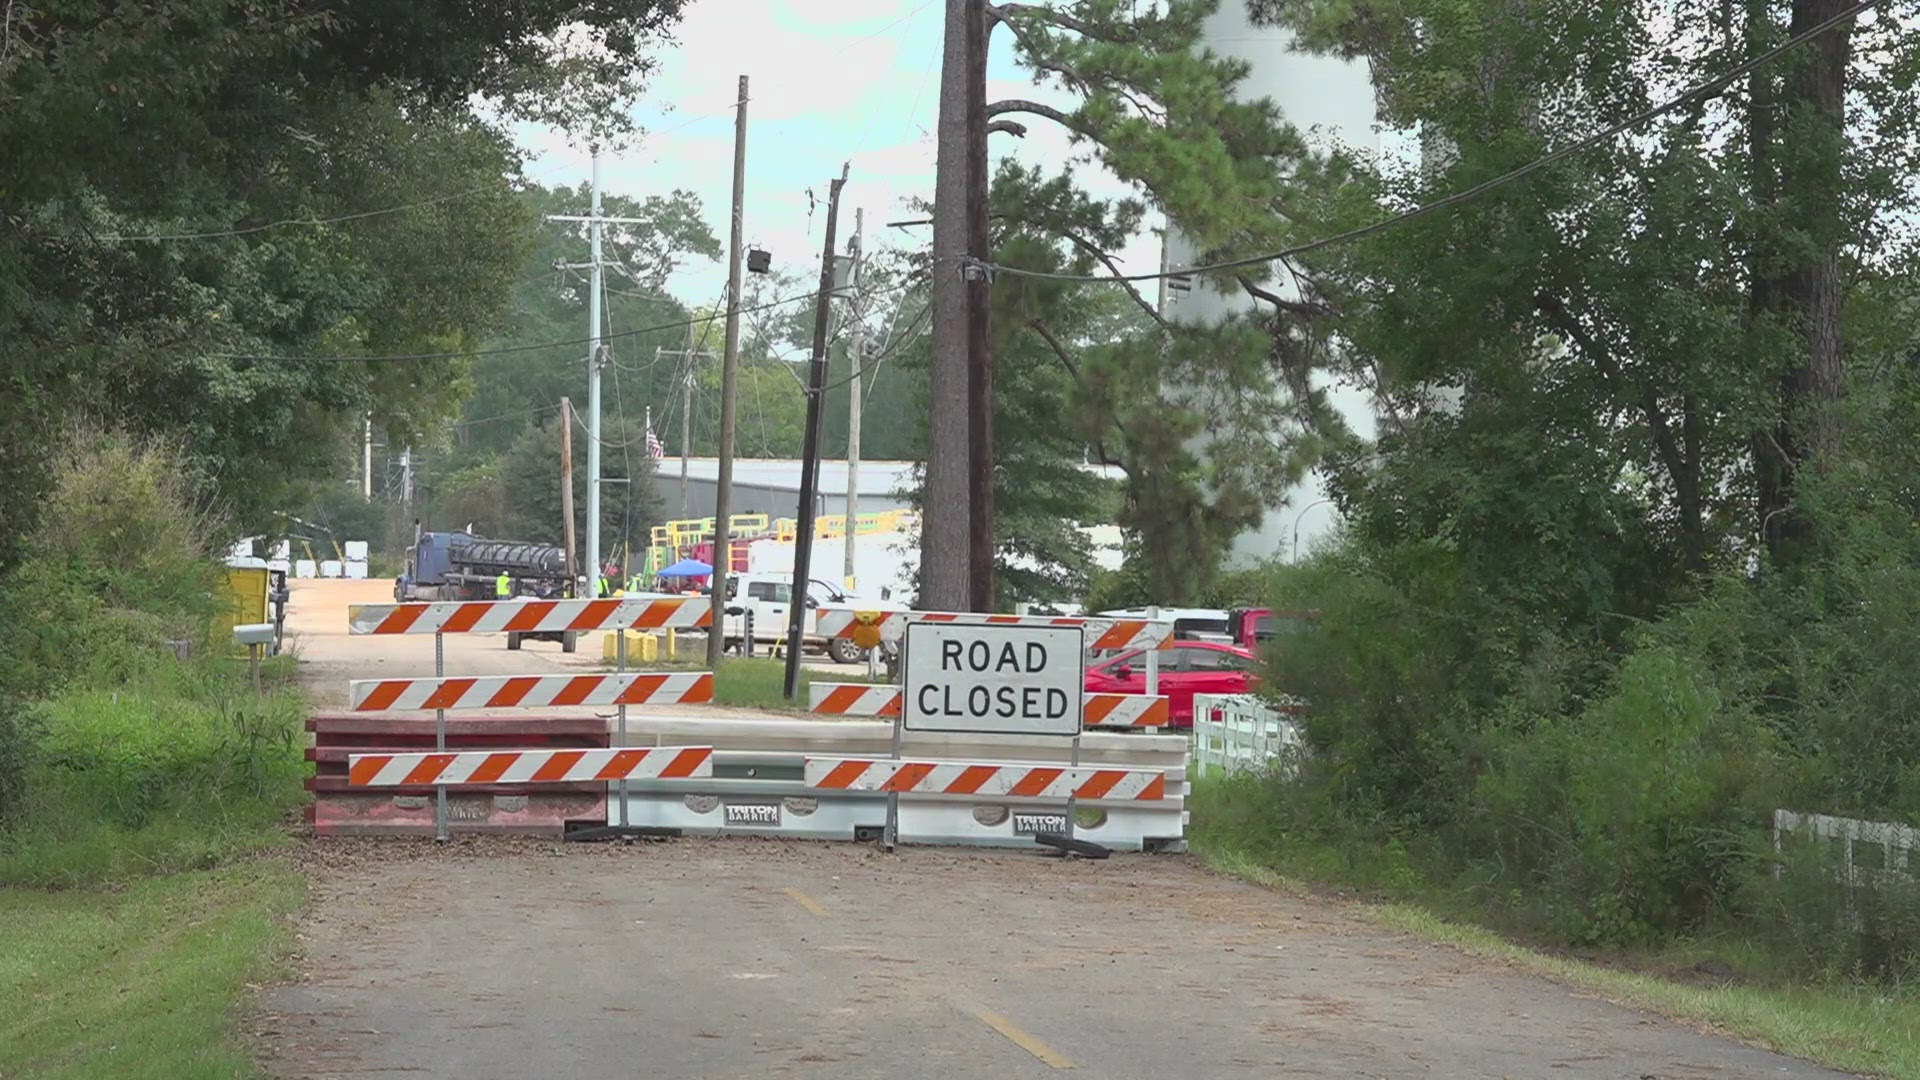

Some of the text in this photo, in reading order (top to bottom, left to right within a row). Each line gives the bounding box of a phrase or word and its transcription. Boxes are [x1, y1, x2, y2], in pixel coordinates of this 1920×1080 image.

[942, 640, 1047, 673] ROAD
[918, 684, 1068, 719] CLOSED
[726, 805, 777, 814] TRITON
[729, 813, 778, 822] BARRIER
[1014, 815, 1066, 825] TRITON
[1017, 824, 1067, 832] BARRIER
